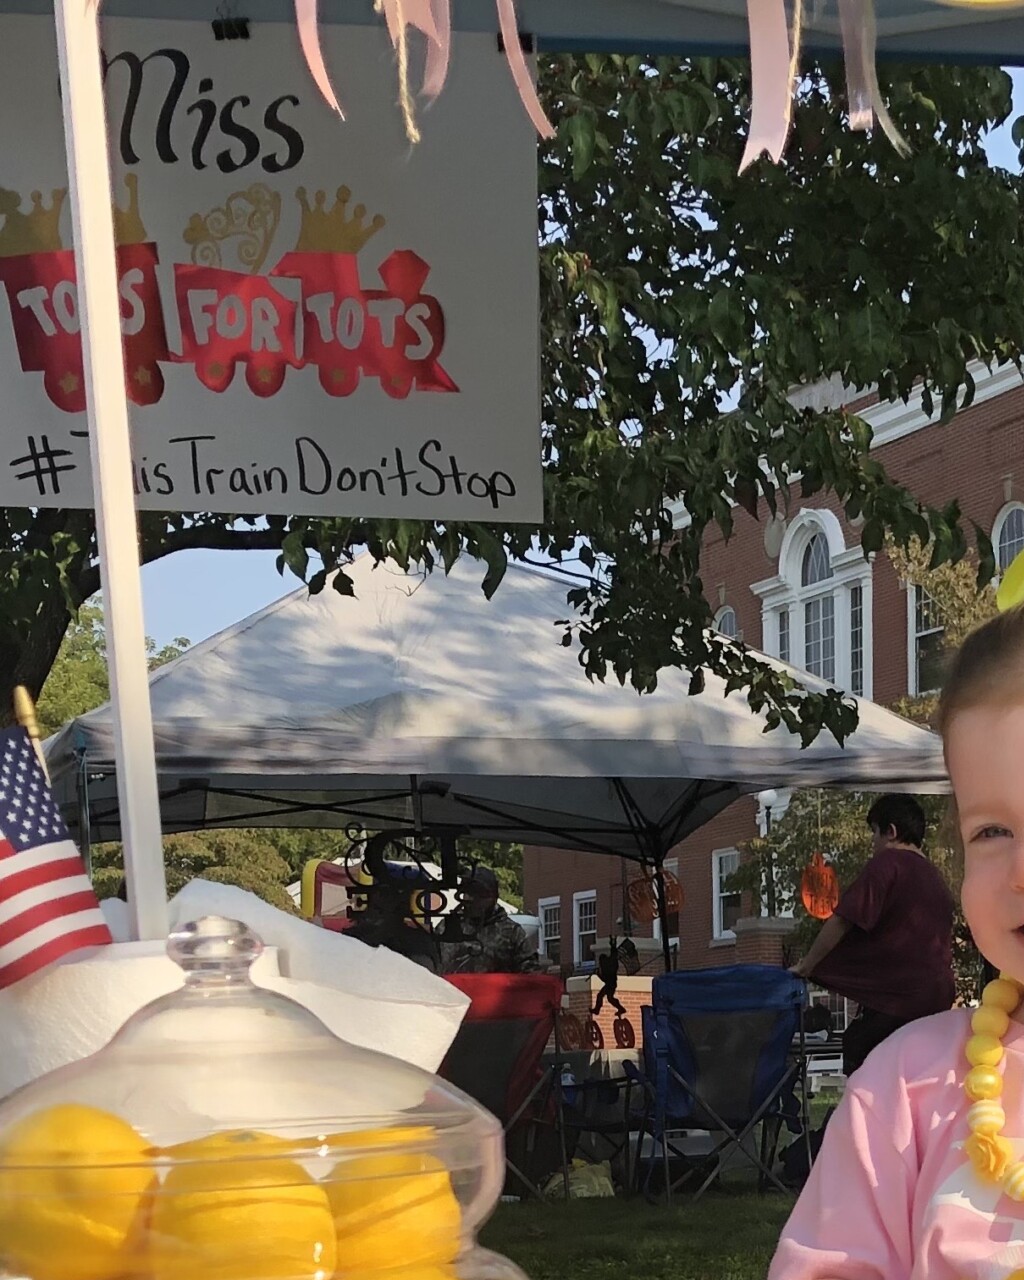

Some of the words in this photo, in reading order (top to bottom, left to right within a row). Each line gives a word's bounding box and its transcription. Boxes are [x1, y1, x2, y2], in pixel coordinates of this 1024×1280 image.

[100, 47, 304, 173] Miss
[18, 268, 146, 337] TOS
[187, 288, 282, 353] FOR
[305, 292, 433, 361] TOTS
